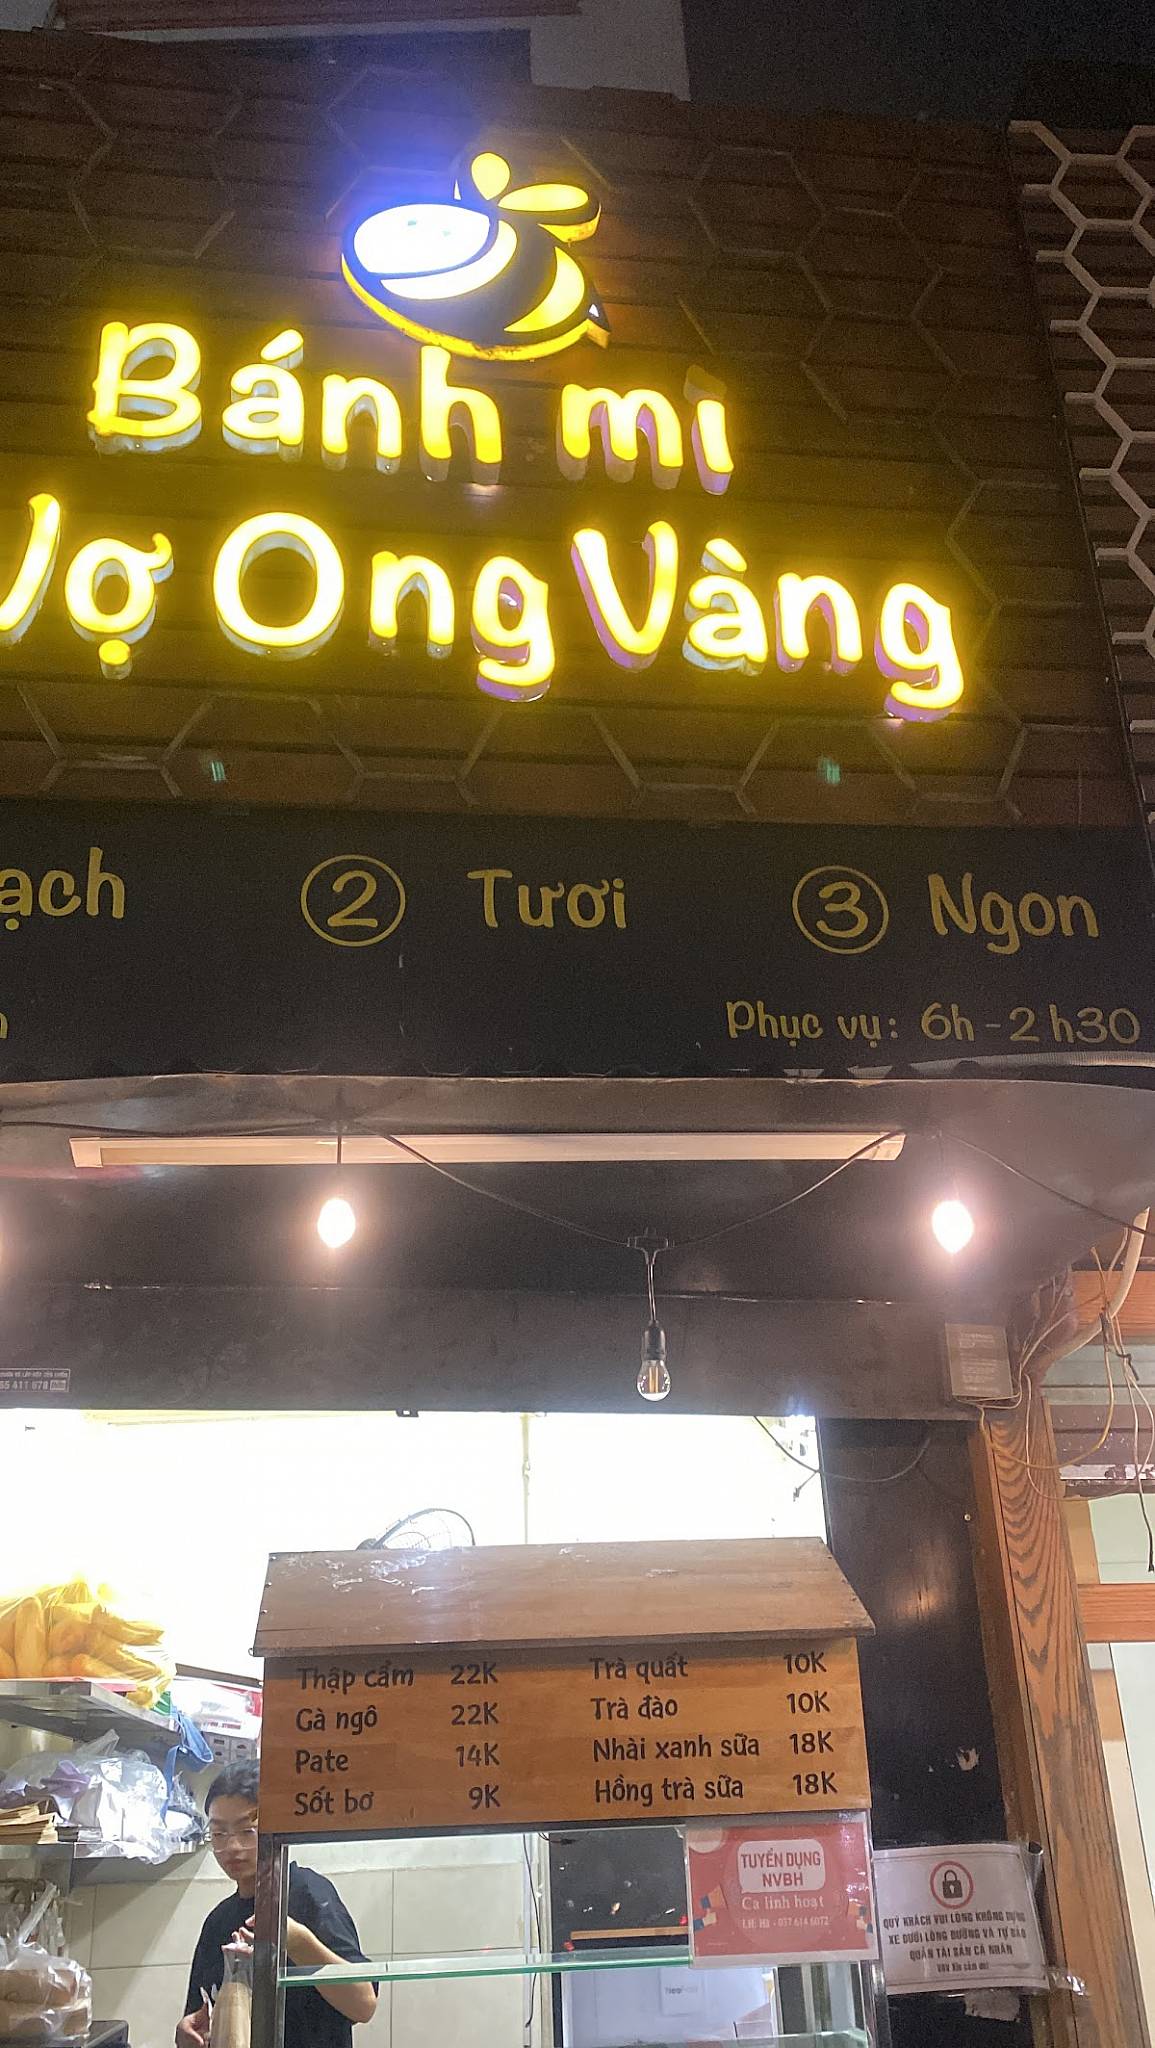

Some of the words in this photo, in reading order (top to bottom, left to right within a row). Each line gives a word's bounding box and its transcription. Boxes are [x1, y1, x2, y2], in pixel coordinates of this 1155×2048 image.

[87, 322, 502, 478] Bánh
[213, 512, 556, 696] Ong
[571, 521, 964, 716] Vàng
[466, 868, 627, 929] Tươi
[928, 872, 1099, 955] Ngon
[726, 1001, 824, 1048] Phục
[837, 1016, 899, 1048] vụ:
[296, 1666, 355, 1694] Thập
[364, 1660, 414, 1688] cẩm
[450, 1661, 498, 1685] 22K
[590, 1656, 627, 1679] Trà
[636, 1652, 688, 1685] quất
[783, 1651, 827, 1674] 10K
[296, 1708, 325, 1732] Gà
[336, 1705, 378, 1736] ngô
[451, 1702, 499, 1726] 22K
[591, 1696, 629, 1720] Trà
[637, 1694, 678, 1720] đào
[786, 1690, 830, 1714] 10K
[295, 1749, 349, 1774] Pate
[455, 1742, 500, 1768] 14K
[593, 1737, 646, 1762] Nhài
[655, 1734, 712, 1760] xanh
[721, 1732, 760, 1758] sữa
[789, 1730, 834, 1755] 18K
[294, 1786, 334, 1816] Sốt
[345, 1788, 375, 1814] bơ
[468, 1784, 500, 1810] 9K
[595, 1773, 653, 1807] Hồng
[662, 1776, 695, 1801] trà
[704, 1774, 744, 1799] sữa
[793, 1770, 838, 1796] 18K
[741, 1847, 784, 1869] TUYỂN
[786, 1850, 821, 1871] DỤNG
[762, 1872, 804, 1887] NVBH
[742, 1896, 760, 1910] Ca
[765, 1895, 790, 1909] linh
[794, 1894, 824, 1910] hoạt
